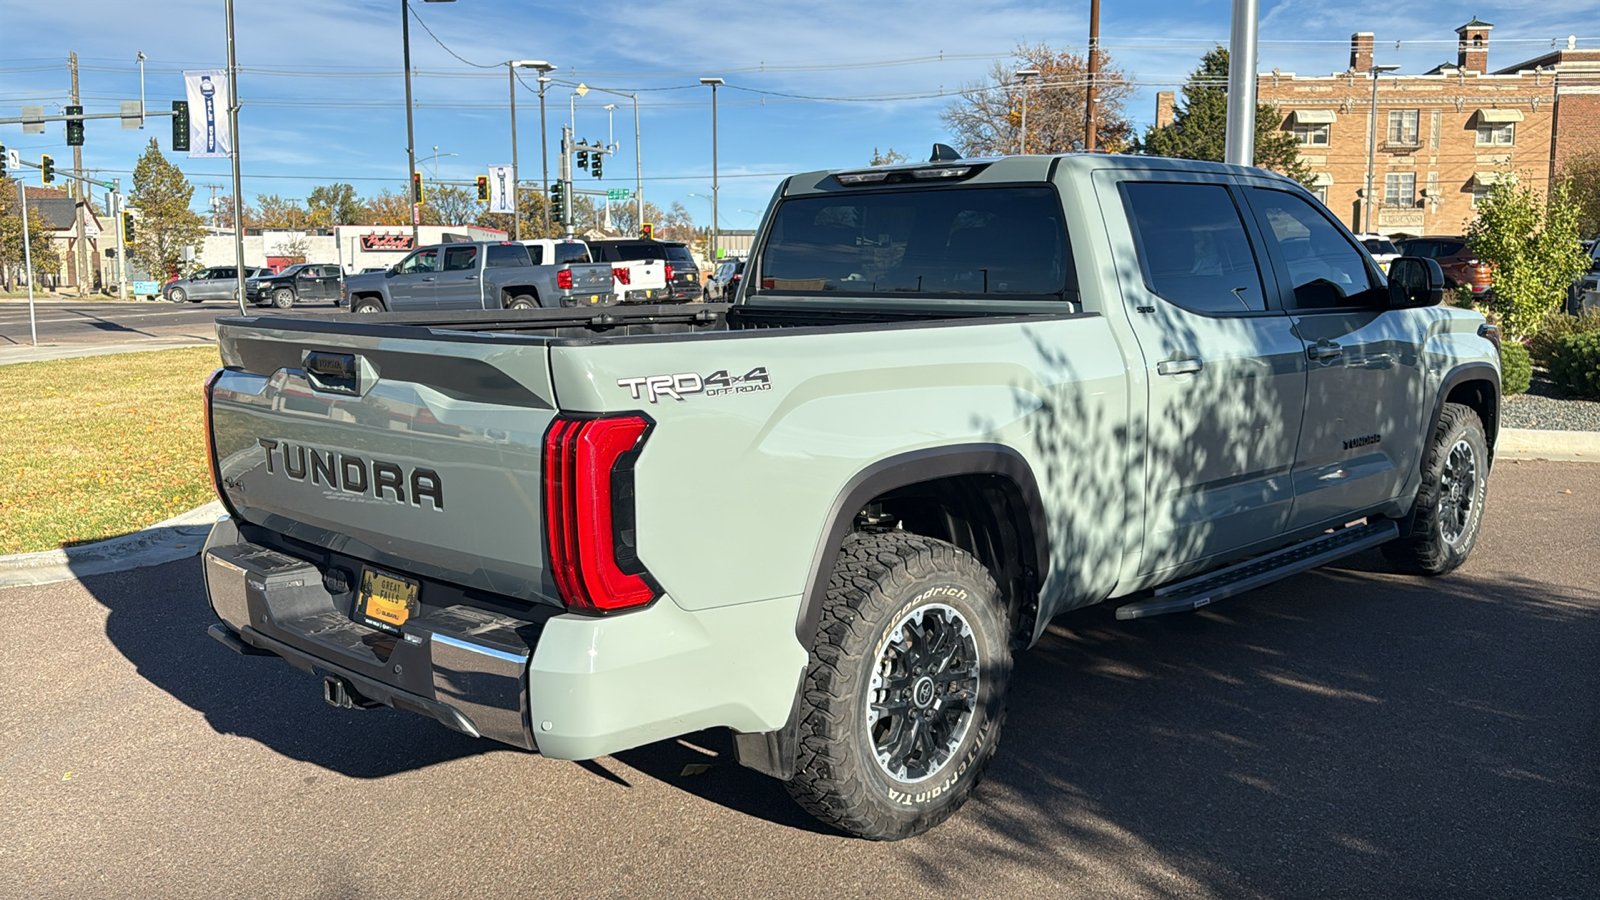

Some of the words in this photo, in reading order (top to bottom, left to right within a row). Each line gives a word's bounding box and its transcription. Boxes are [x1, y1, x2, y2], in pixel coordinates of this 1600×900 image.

[616, 372, 704, 404] TRD
[706, 387, 733, 397] OFF
[735, 384, 773, 394] ROAD
[1342, 433, 1381, 450] TUNDRA
[256, 437, 444, 513] TUNDRA
[381, 580, 401, 593] GREAT
[380, 590, 400, 604] FALLS
[381, 610, 400, 621] SUBARU
[888, 787, 913, 806] T/A
